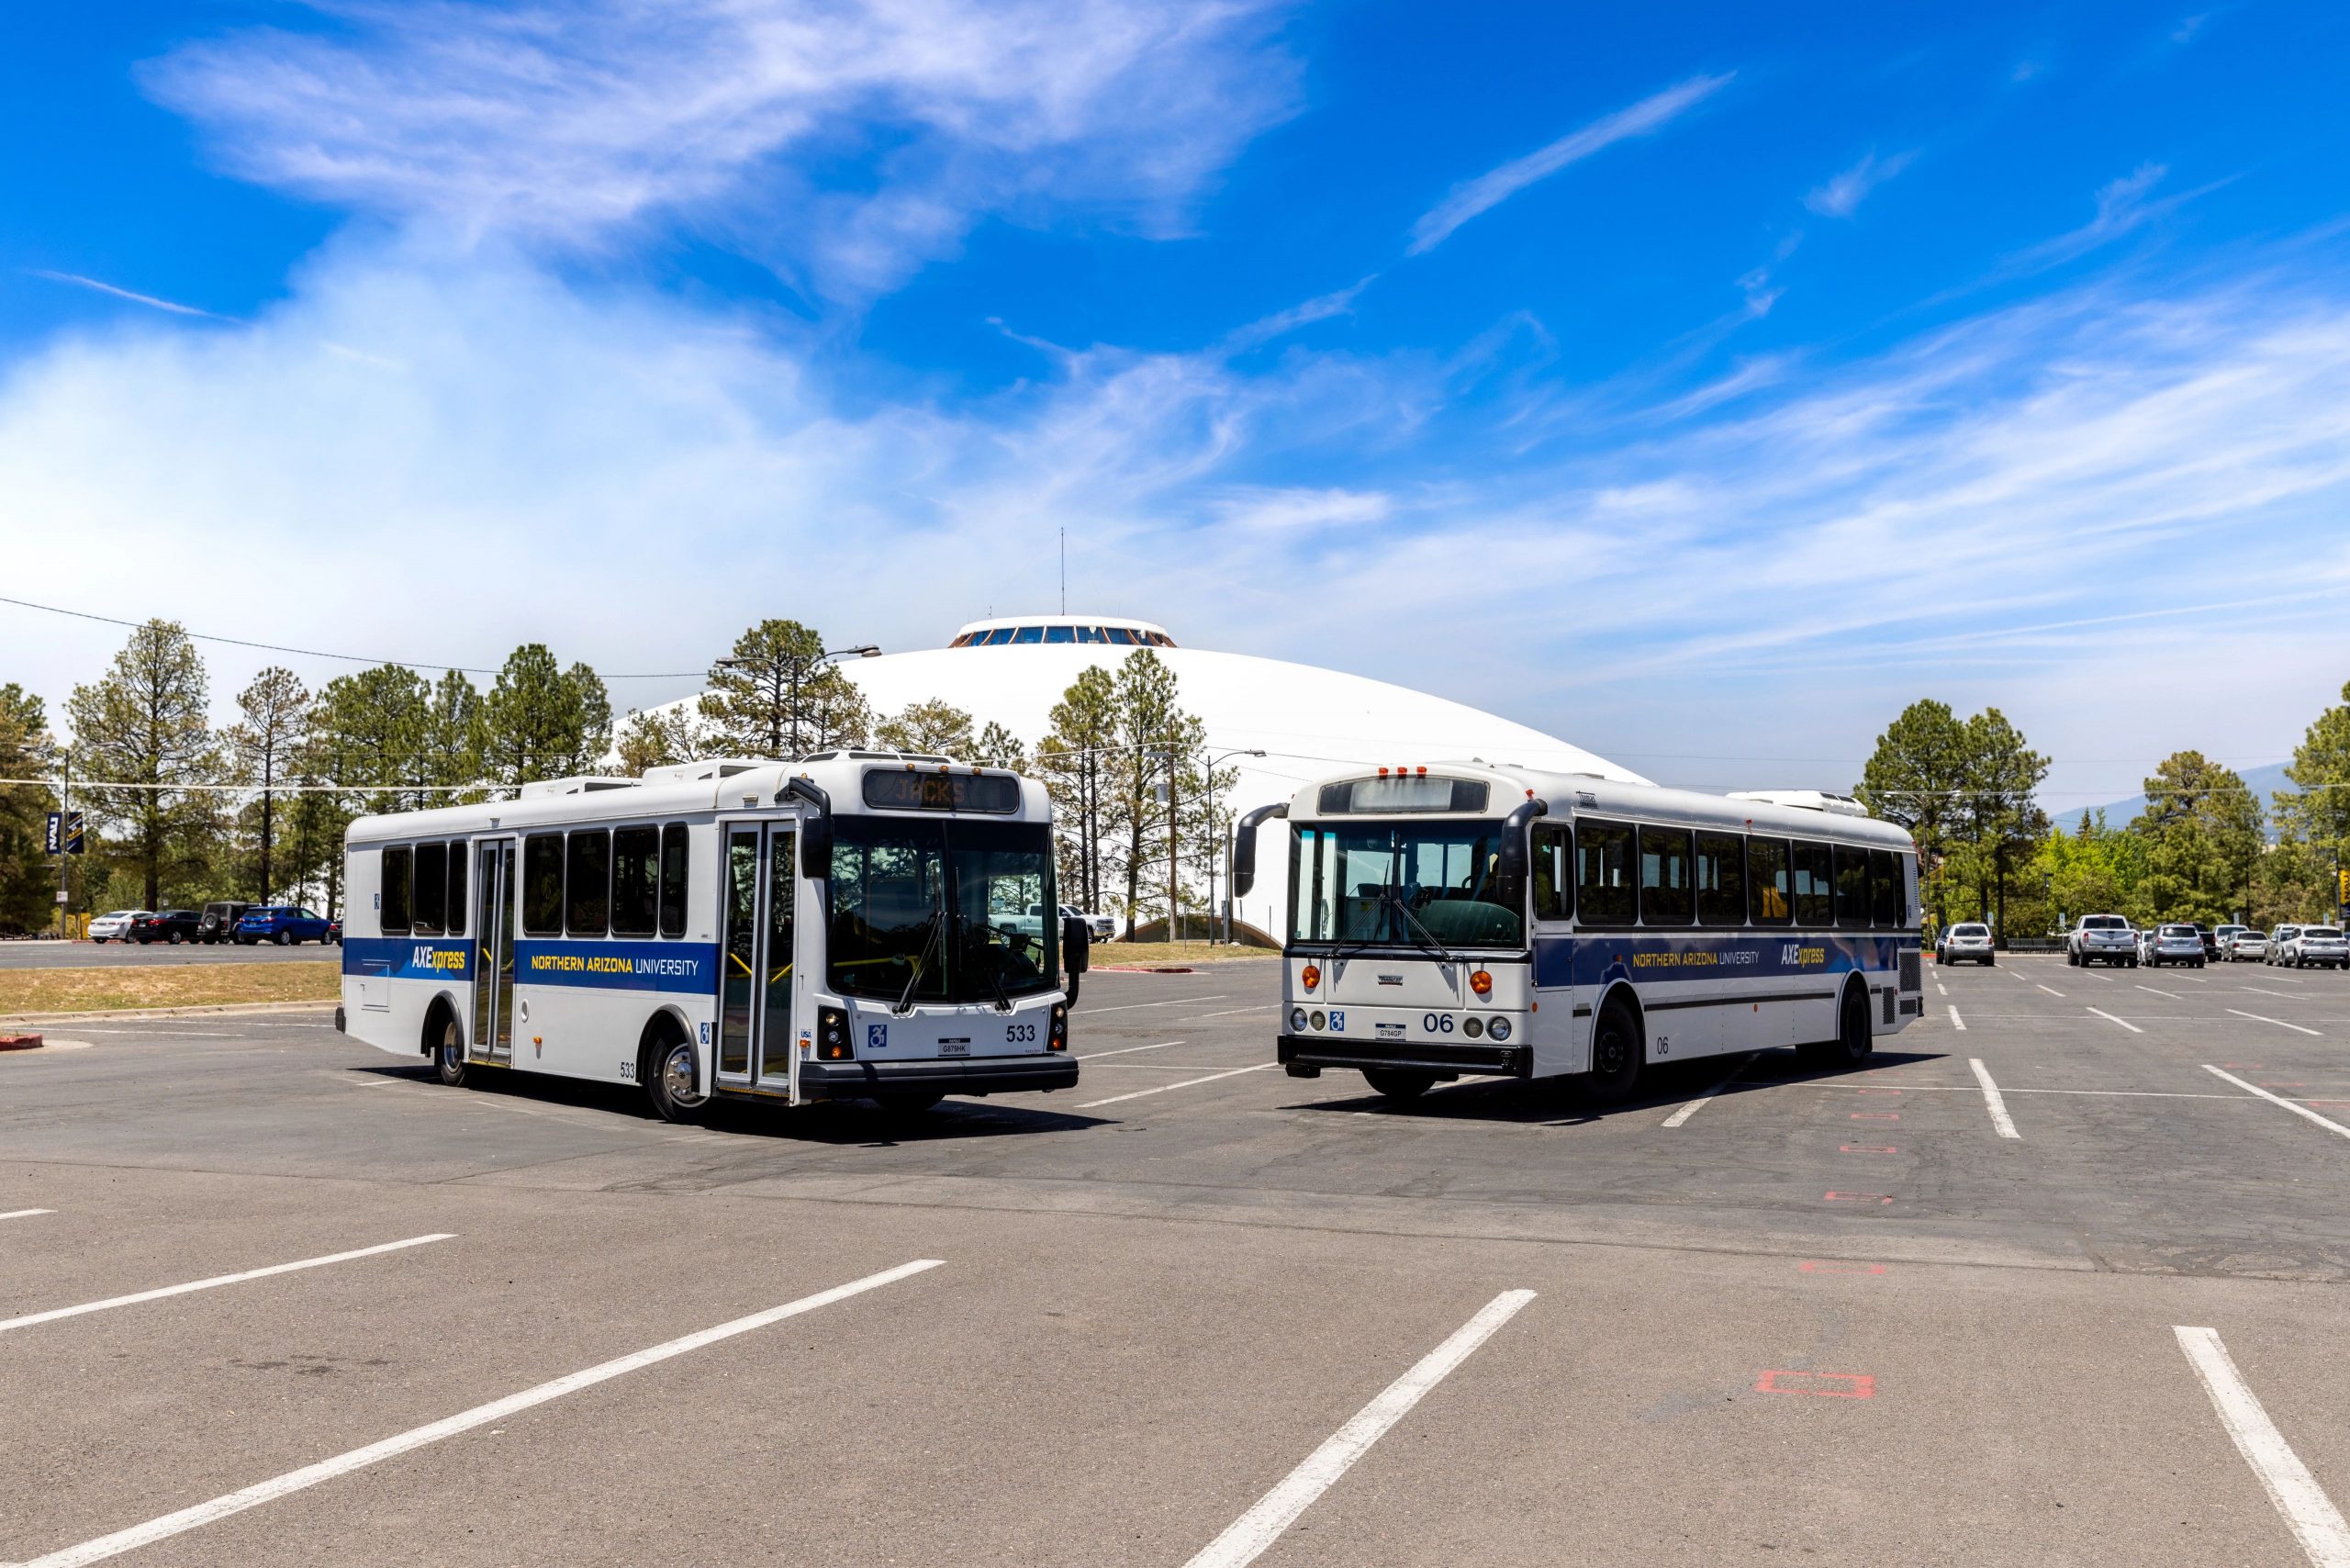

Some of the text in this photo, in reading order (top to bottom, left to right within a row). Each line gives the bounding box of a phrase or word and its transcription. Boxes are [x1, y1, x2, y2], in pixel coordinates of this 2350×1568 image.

[896, 778, 964, 802] JACKS
[49, 817, 59, 851] NAU
[411, 946, 465, 974] AXExpress
[532, 956, 699, 976] NORTHERN ARIZONA UNIVERSITY
[1633, 951, 1760, 968] NORTHERN ARIZONA UNIVERSITY
[1781, 944, 1825, 969] AXExpress
[1423, 1013, 1454, 1034] 06
[1006, 1025, 1035, 1043] 533
[1657, 1036, 1669, 1055] 06
[620, 1061, 635, 1079] 533
